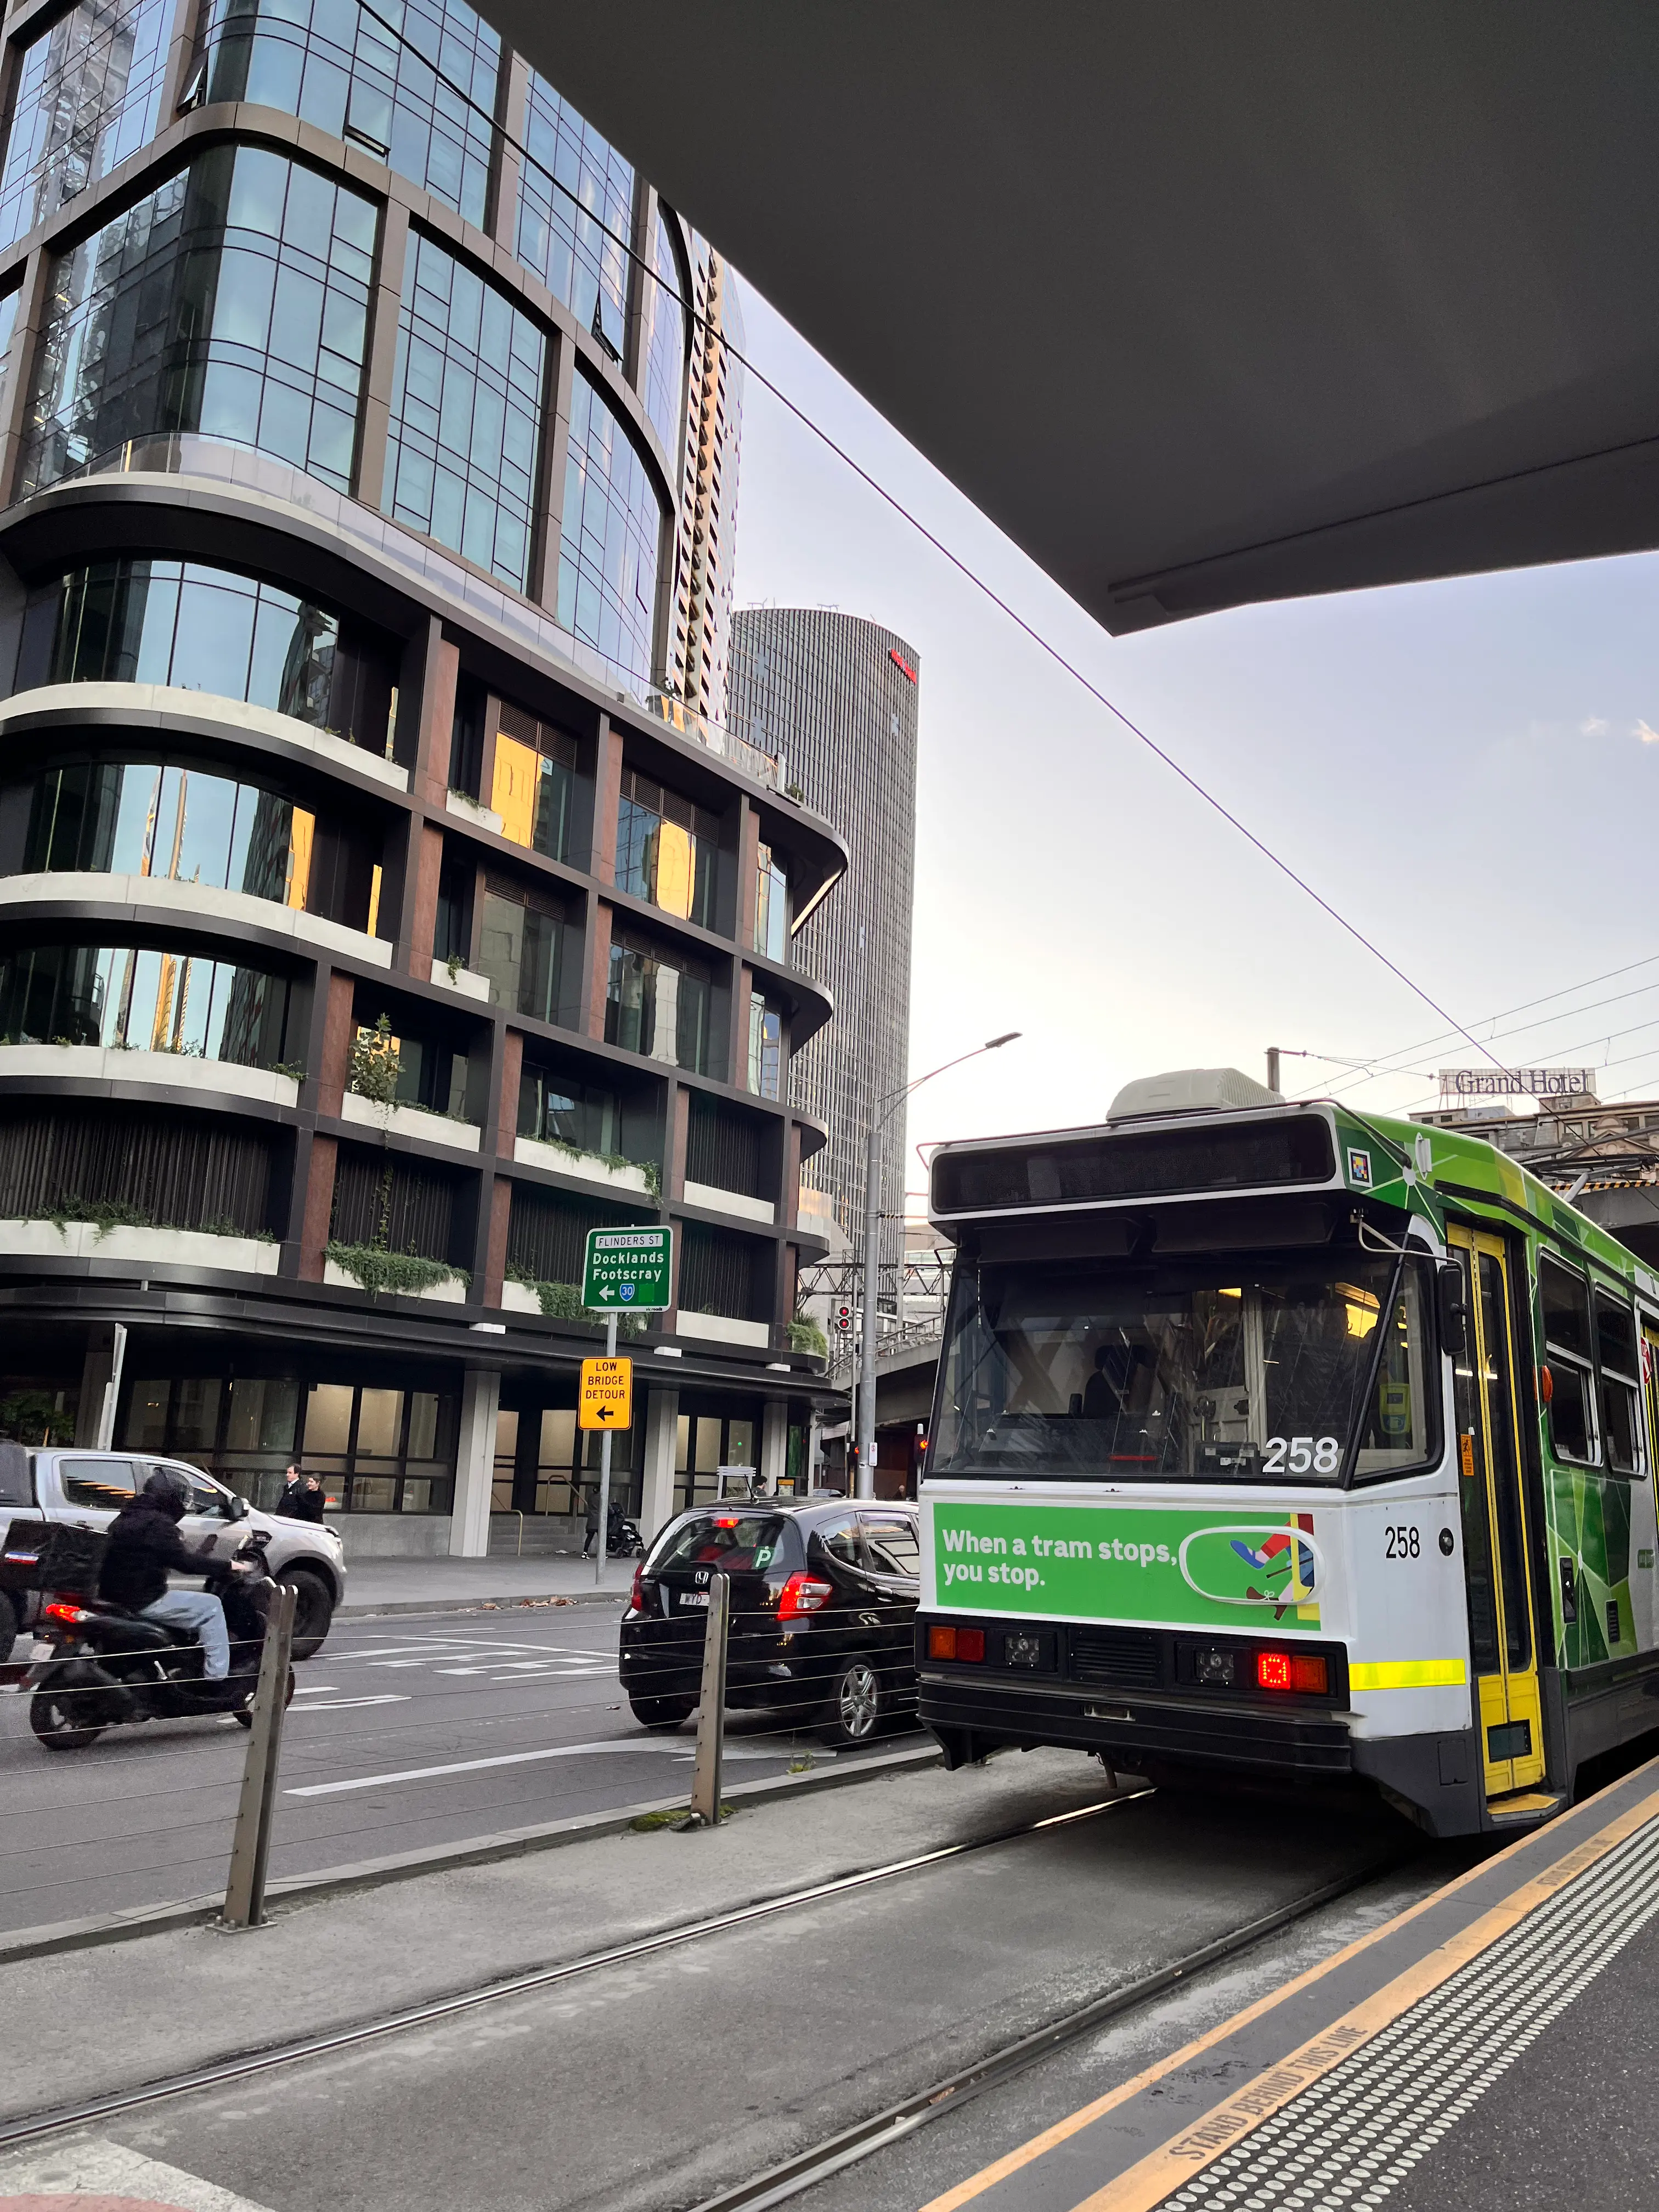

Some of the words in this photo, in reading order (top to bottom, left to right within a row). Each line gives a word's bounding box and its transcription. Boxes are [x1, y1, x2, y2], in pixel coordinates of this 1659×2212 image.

[1455, 1070, 1523, 1094] Grand
[1528, 1069, 1589, 1093] Hotel
[599, 1237, 645, 1246] FLINDERS
[648, 1235, 659, 1245] ST
[592, 1251, 664, 1265] Docklands
[592, 1268, 662, 1282] Footscray
[622, 1286, 633, 1296] 30
[596, 1362, 617, 1372] LOW
[588, 1375, 624, 1385] BRIDGE
[585, 1390, 625, 1399] DETOUR
[1262, 1437, 1339, 1473] 258
[942, 1529, 1007, 1554] When
[1012, 1538, 1026, 1555] a
[1031, 1535, 1092, 1559] tram
[1098, 1538, 1177, 1568] stops,
[1385, 1526, 1420, 1559] 258
[943, 1563, 983, 1585] you
[988, 1562, 1045, 1591] stop.
[1169, 2114, 1249, 2160] STAND
[1229, 2070, 1305, 2117] BEHIND
[1287, 2046, 1339, 2073] THIS
[1319, 2025, 1368, 2049] LINE
